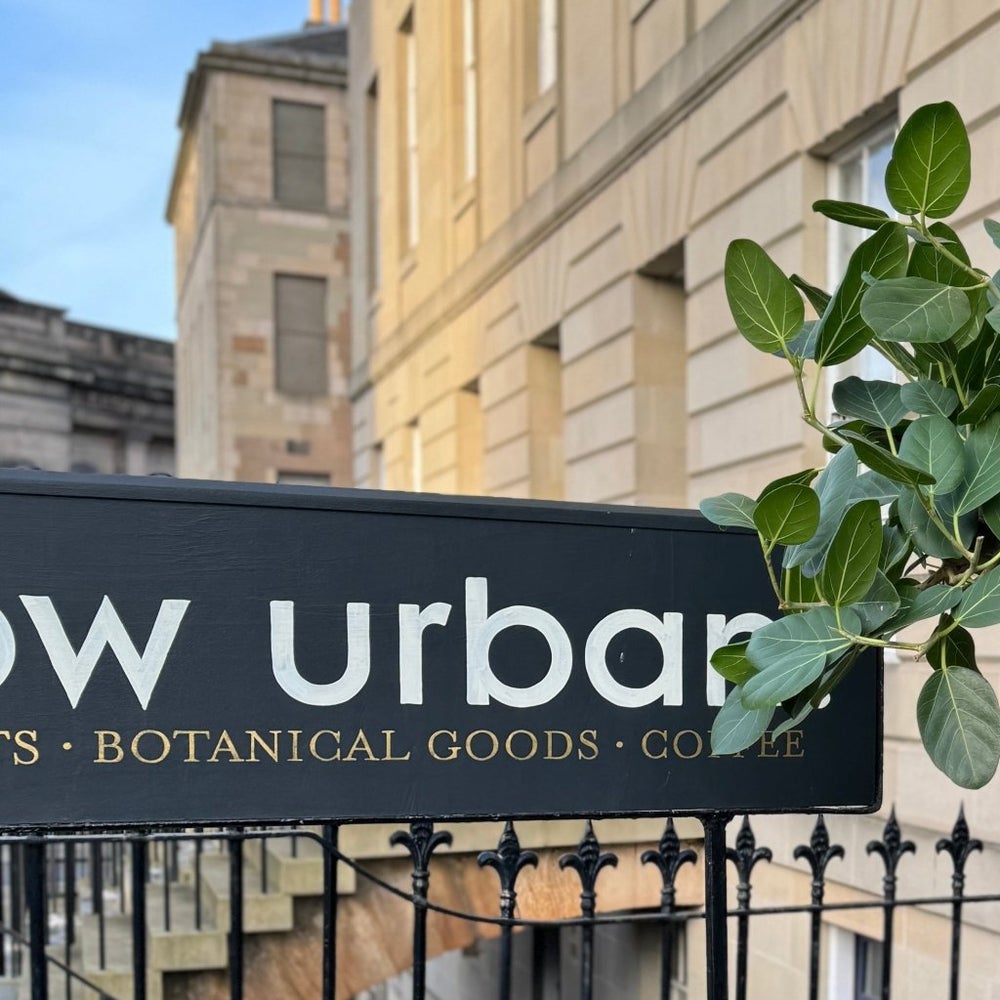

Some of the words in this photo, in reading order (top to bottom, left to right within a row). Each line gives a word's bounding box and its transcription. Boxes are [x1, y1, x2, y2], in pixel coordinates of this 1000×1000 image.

[0, 594, 191, 711] w
[93, 729, 409, 764] BOTANICAL
[428, 729, 599, 762] GOODS
[640, 729, 805, 760] COEE
